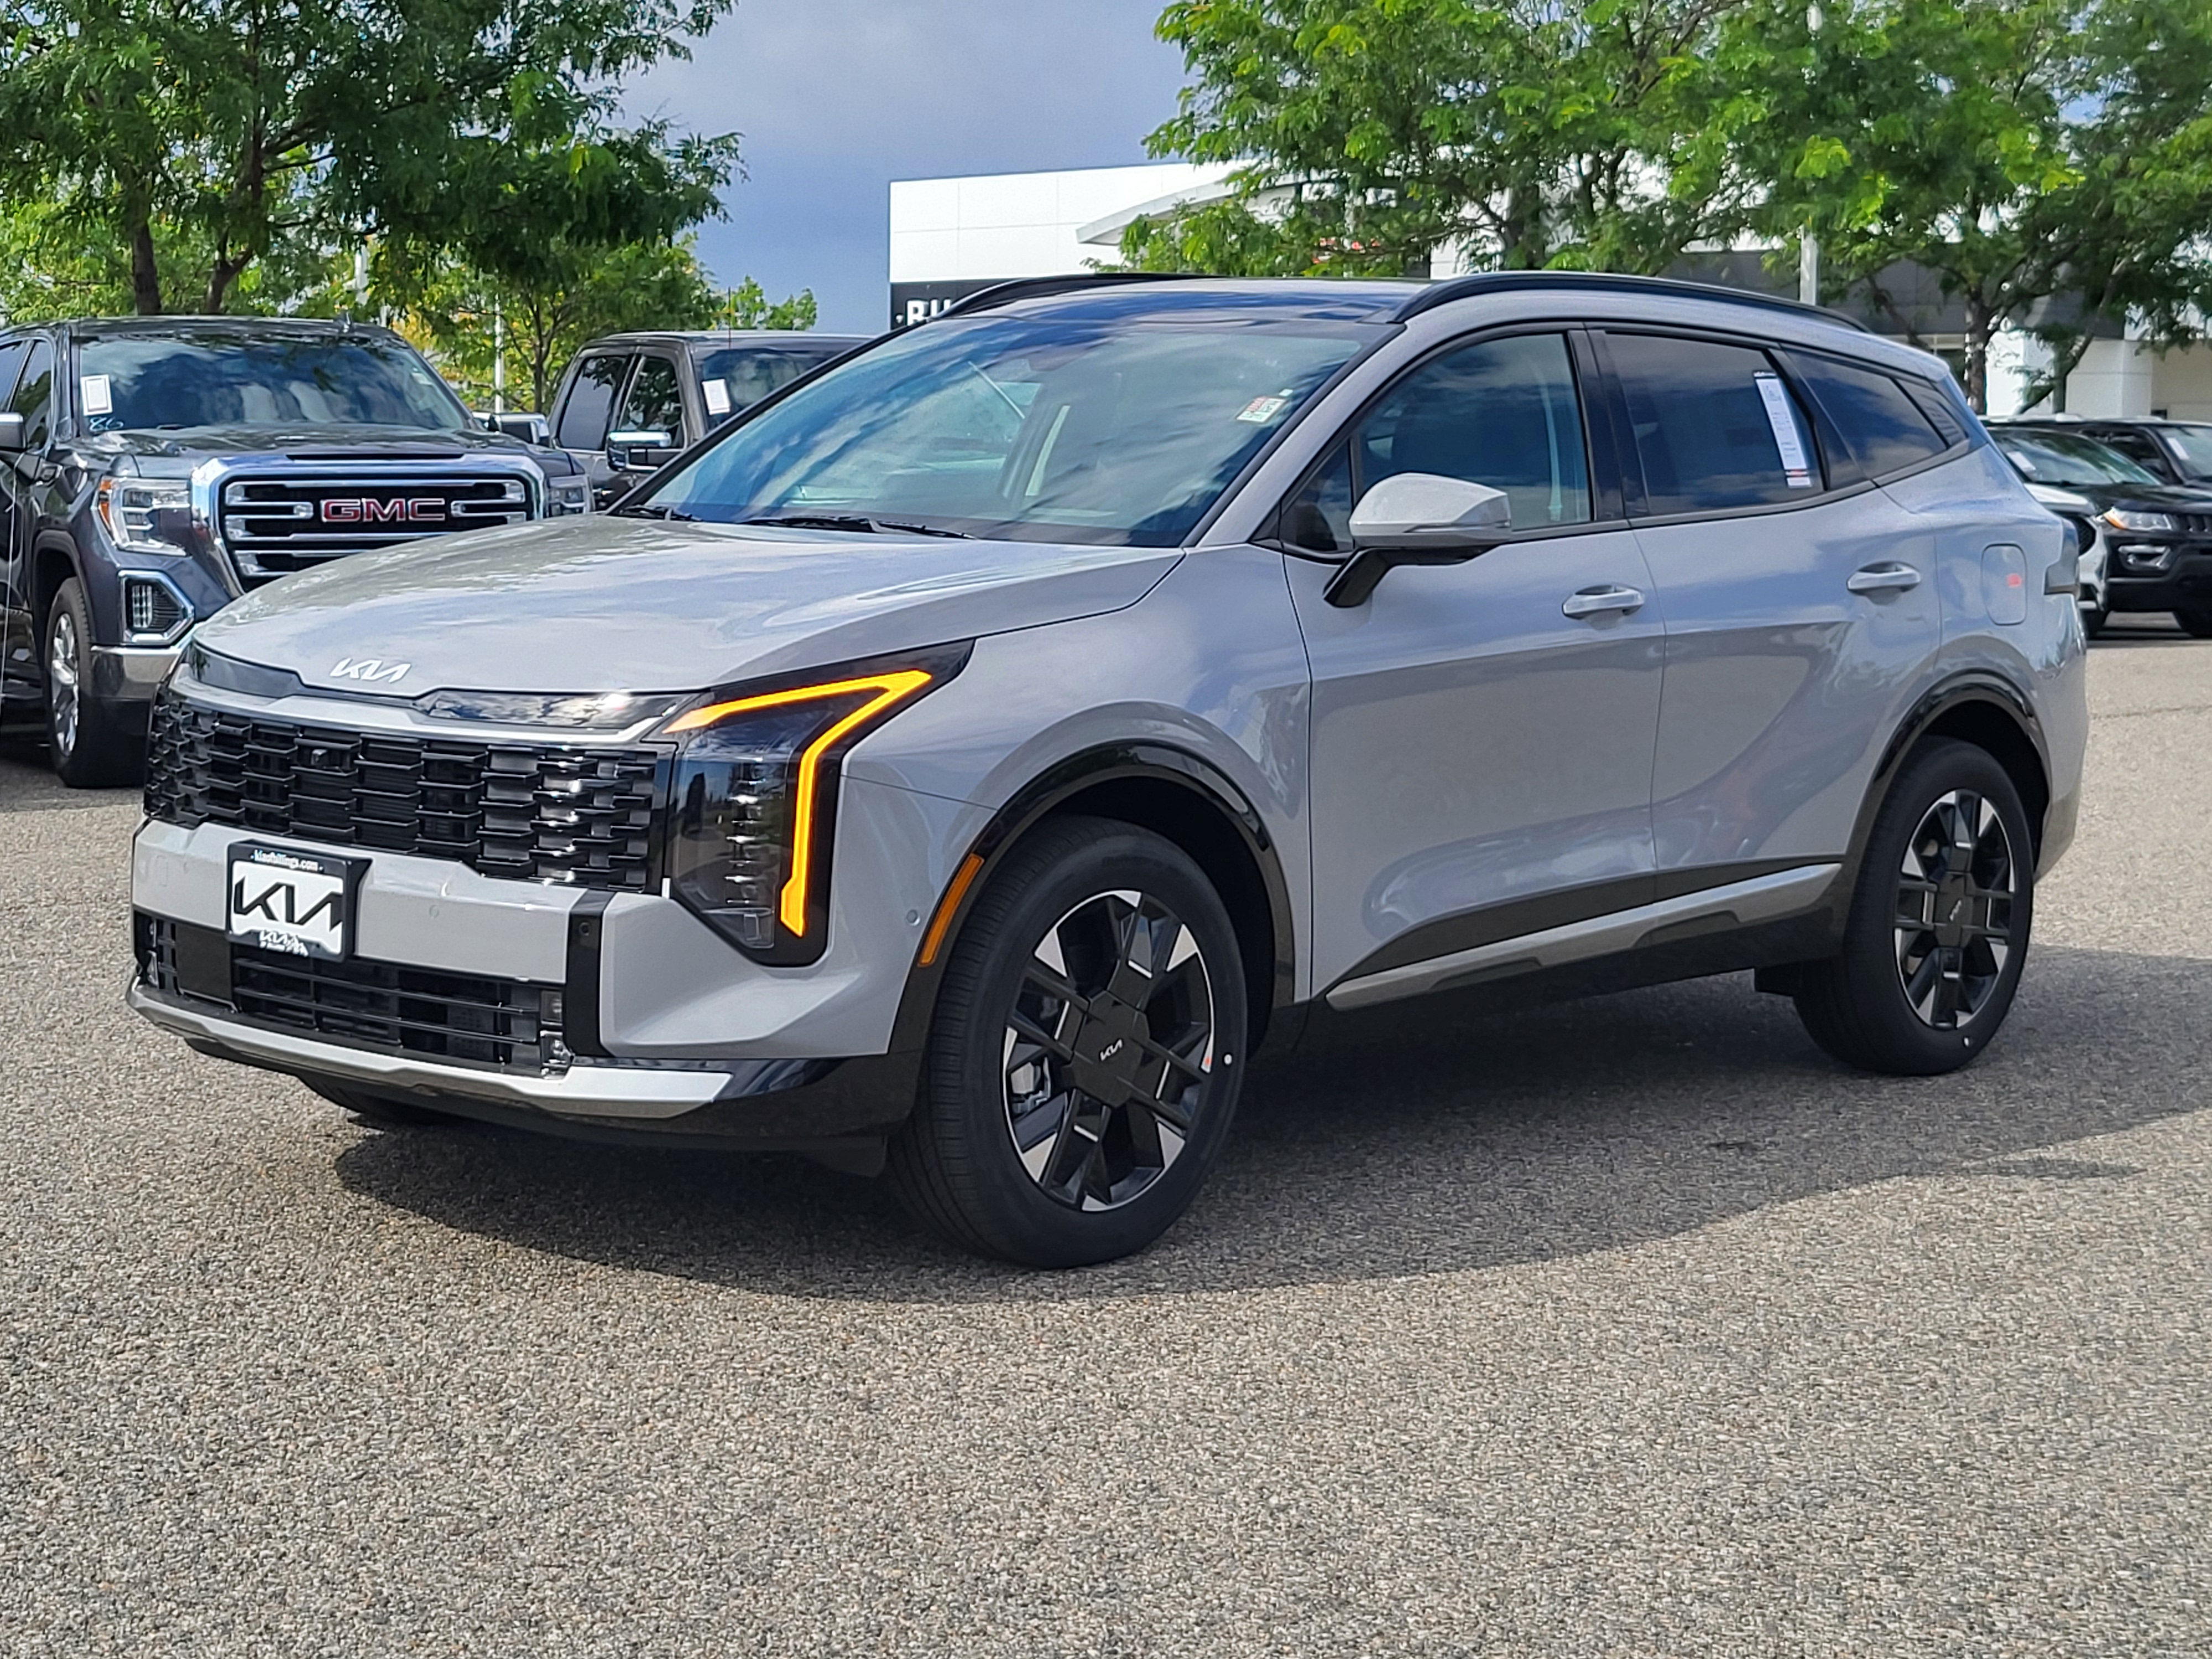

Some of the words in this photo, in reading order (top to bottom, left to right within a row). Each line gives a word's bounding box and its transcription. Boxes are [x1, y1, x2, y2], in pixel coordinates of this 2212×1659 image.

[320, 498, 445, 522] GMC
[330, 658, 411, 684] KIA
[234, 875, 343, 932] KIA
[1099, 1039, 1123, 1061] KIA
